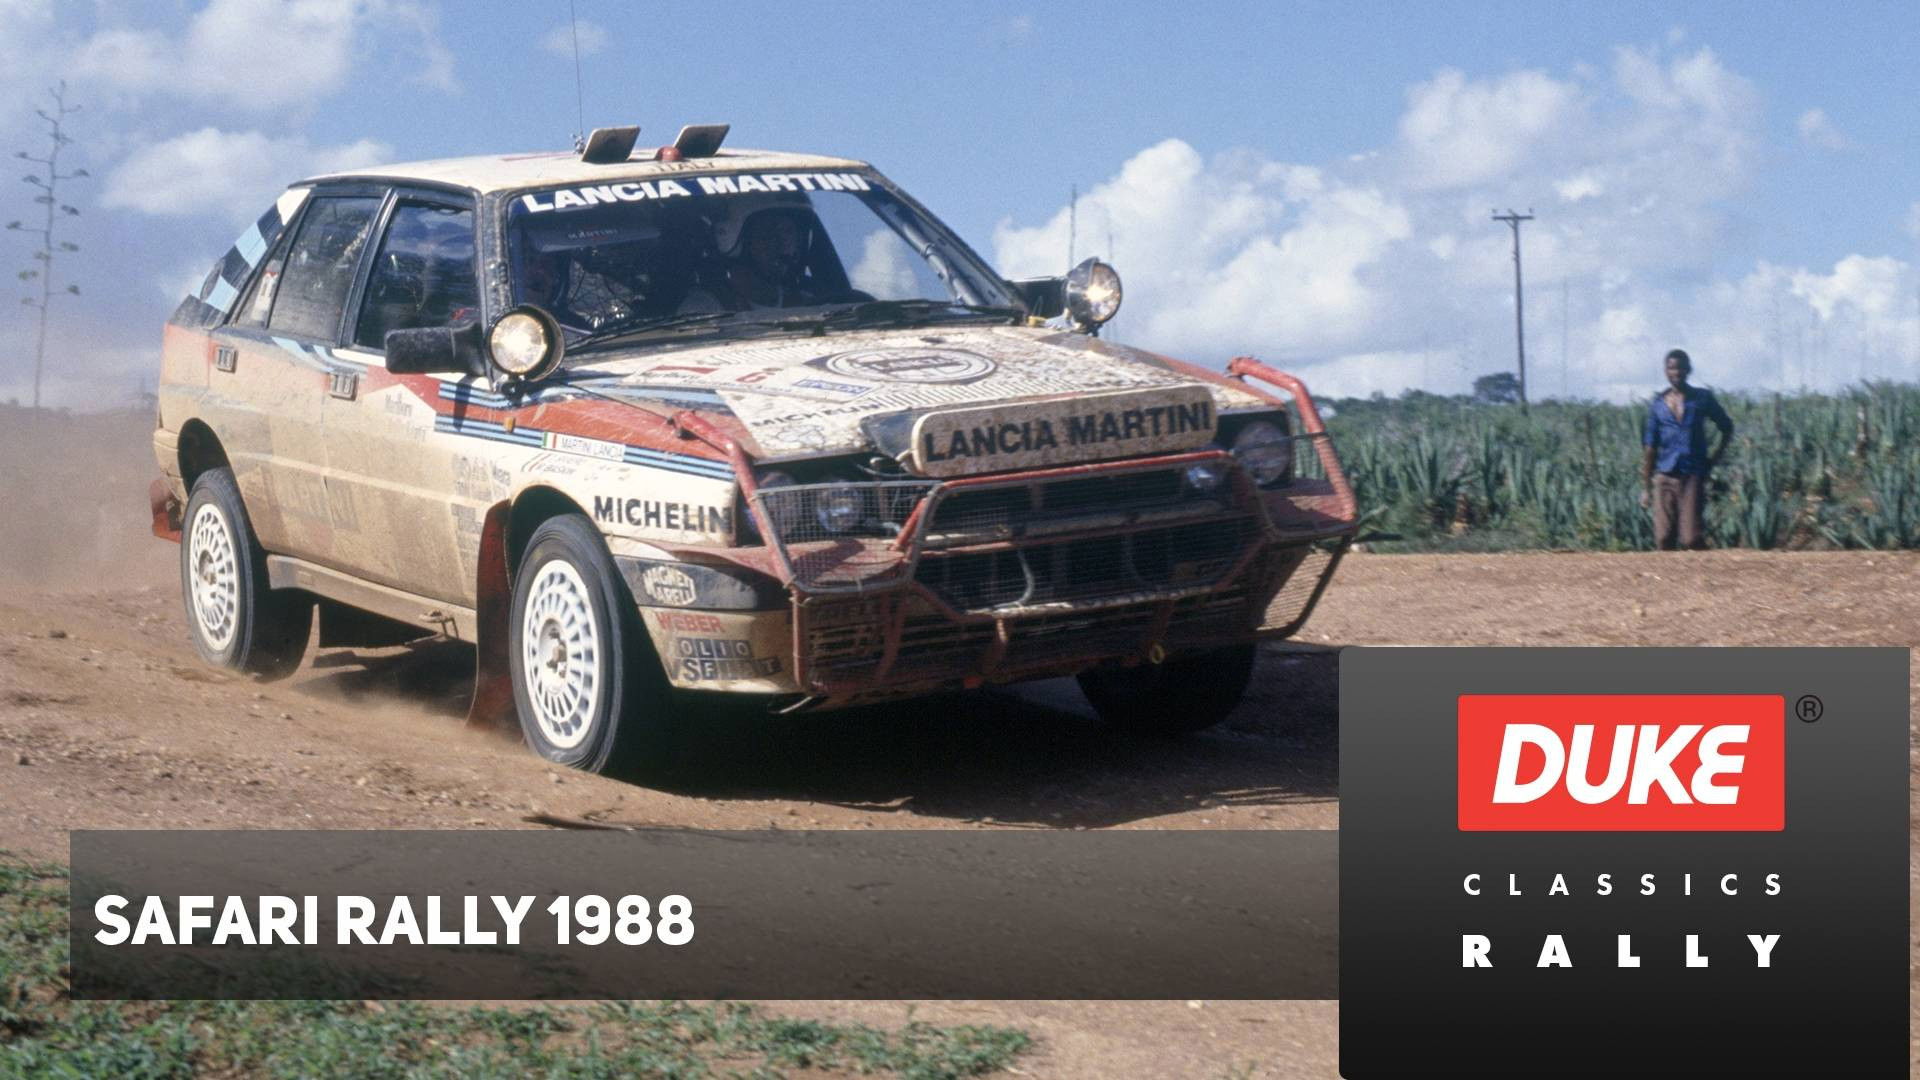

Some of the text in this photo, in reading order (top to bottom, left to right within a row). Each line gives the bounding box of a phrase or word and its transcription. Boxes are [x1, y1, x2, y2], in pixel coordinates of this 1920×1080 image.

[522, 173, 871, 213] LANCIA MARTINI
[751, 401, 883, 428] MICHELIN
[924, 401, 1209, 462] LANCIA MARTINI
[562, 436, 623, 459] MARTINI LANCIA
[594, 495, 734, 534] MICHELIN
[655, 611, 726, 633] WEBER
[679, 638, 750, 657] OLIO
